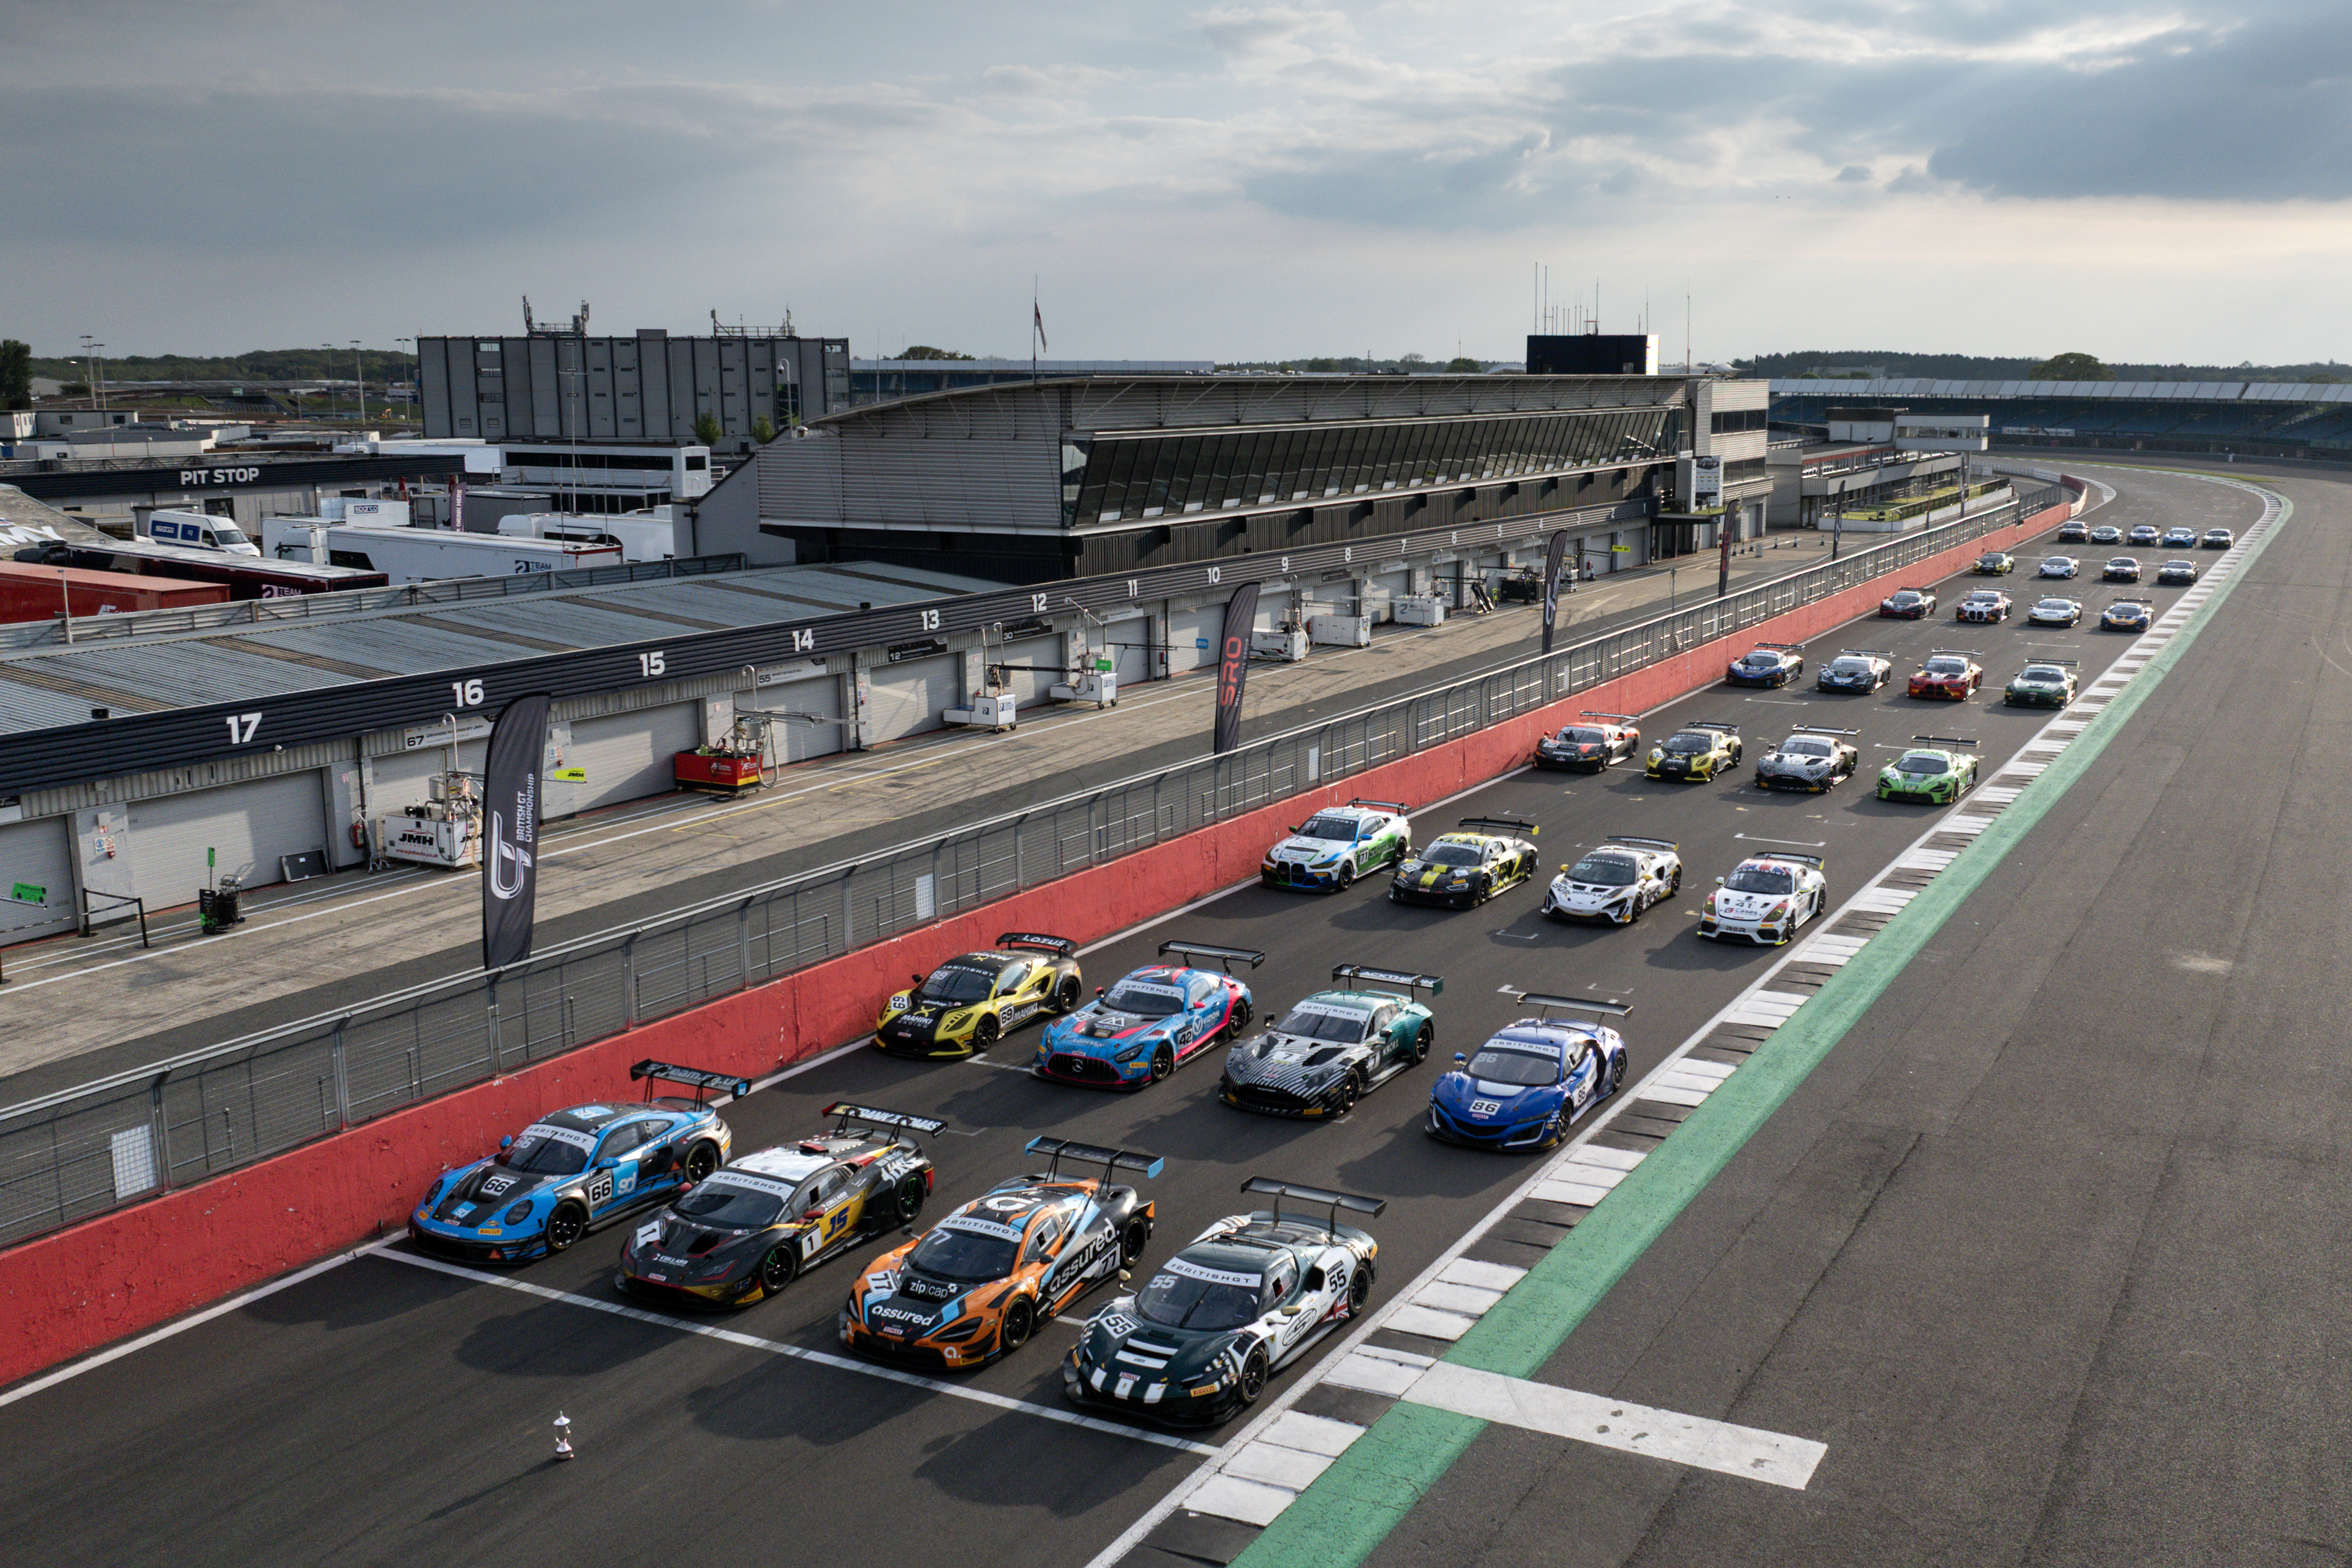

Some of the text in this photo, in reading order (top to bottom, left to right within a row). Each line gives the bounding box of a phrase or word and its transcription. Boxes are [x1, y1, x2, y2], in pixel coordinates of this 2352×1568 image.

[181, 468, 259, 485] PIT STOP
[1611, 508, 1615, 518] 2
[1644, 503, 1646, 513] 1
[1539, 519, 1543, 529] 4
[1576, 513, 1581, 524] 3
[1452, 531, 1457, 544] 6
[1498, 525, 1502, 537] 5
[1401, 539, 1406, 553] 7
[1345, 548, 1351, 562] 8
[1281, 557, 1289, 572] 9
[1207, 567, 1220, 583] 10
[279, 587, 301, 595] TEAM
[1128, 579, 1138, 597] 11
[1032, 593, 1047, 613] 12
[921, 610, 940, 630] 13
[792, 629, 814, 652] 14
[639, 652, 665, 676] 15
[1221, 637, 1241, 706] SRO
[759, 675, 771, 683] 55
[452, 680, 484, 707] 16
[226, 713, 262, 744] 17
[407, 735, 424, 747] 67
[525, 773, 534, 842] CHAMPIONSHIP
[516, 791, 526, 841] BRITISH GT
[399, 833, 434, 846] JMH
[1361, 852, 1368, 862] 71
[1552, 883, 1567, 892] 90
[1022, 935, 1066, 946] LOTUS
[929, 970, 949, 980] 69
[943, 965, 995, 976] #BRITISHGT
[1108, 990, 1127, 1000] 42
[1120, 983, 1175, 996] #BRITISHGT
[893, 996, 906, 1009] 69
[1002, 1008, 1013, 1024] 69
[1013, 1003, 1040, 1022] MAHIKI
[1301, 1005, 1359, 1017] #BRITISHGT
[902, 1014, 934, 1024] MAHIKI
[1071, 1038, 1106, 1048] Ashbridge
[1180, 1031, 1192, 1046] 42
[1383, 1039, 1399, 1056] KROLL
[1493, 1040, 1556, 1053] #BRITISHGT
[1476, 1052, 1498, 1063] 86
[1578, 1086, 1586, 1103] 86
[1472, 1102, 1498, 1112] 86
[889, 1115, 942, 1131] TOMAS
[513, 1136, 536, 1149] 66
[529, 1127, 588, 1143] #BRITISHGT
[484, 1178, 510, 1192] 66
[719, 1175, 784, 1192] #BRITISHGT
[592, 1181, 611, 1202] 66
[826, 1191, 847, 1207] COLLARD
[824, 1205, 850, 1242] JS
[945, 1219, 1019, 1237] #BRITISHGT
[641, 1228, 657, 1238] 1
[927, 1229, 953, 1245] 77
[807, 1235, 814, 1252] 1
[660, 1255, 689, 1265] COLLARD
[1049, 1217, 1120, 1293] assured.
[1101, 1249, 1120, 1274] 77
[1171, 1264, 1251, 1284] #BRITISHGT
[1329, 1268, 1347, 1294] 55
[871, 1272, 893, 1292] 77
[1149, 1275, 1179, 1289] 55
[871, 1305, 936, 1326] assured
[1105, 1316, 1133, 1335] 55
[944, 1346, 962, 1359] a.
[1193, 1387, 1215, 1396] PIRELLI
